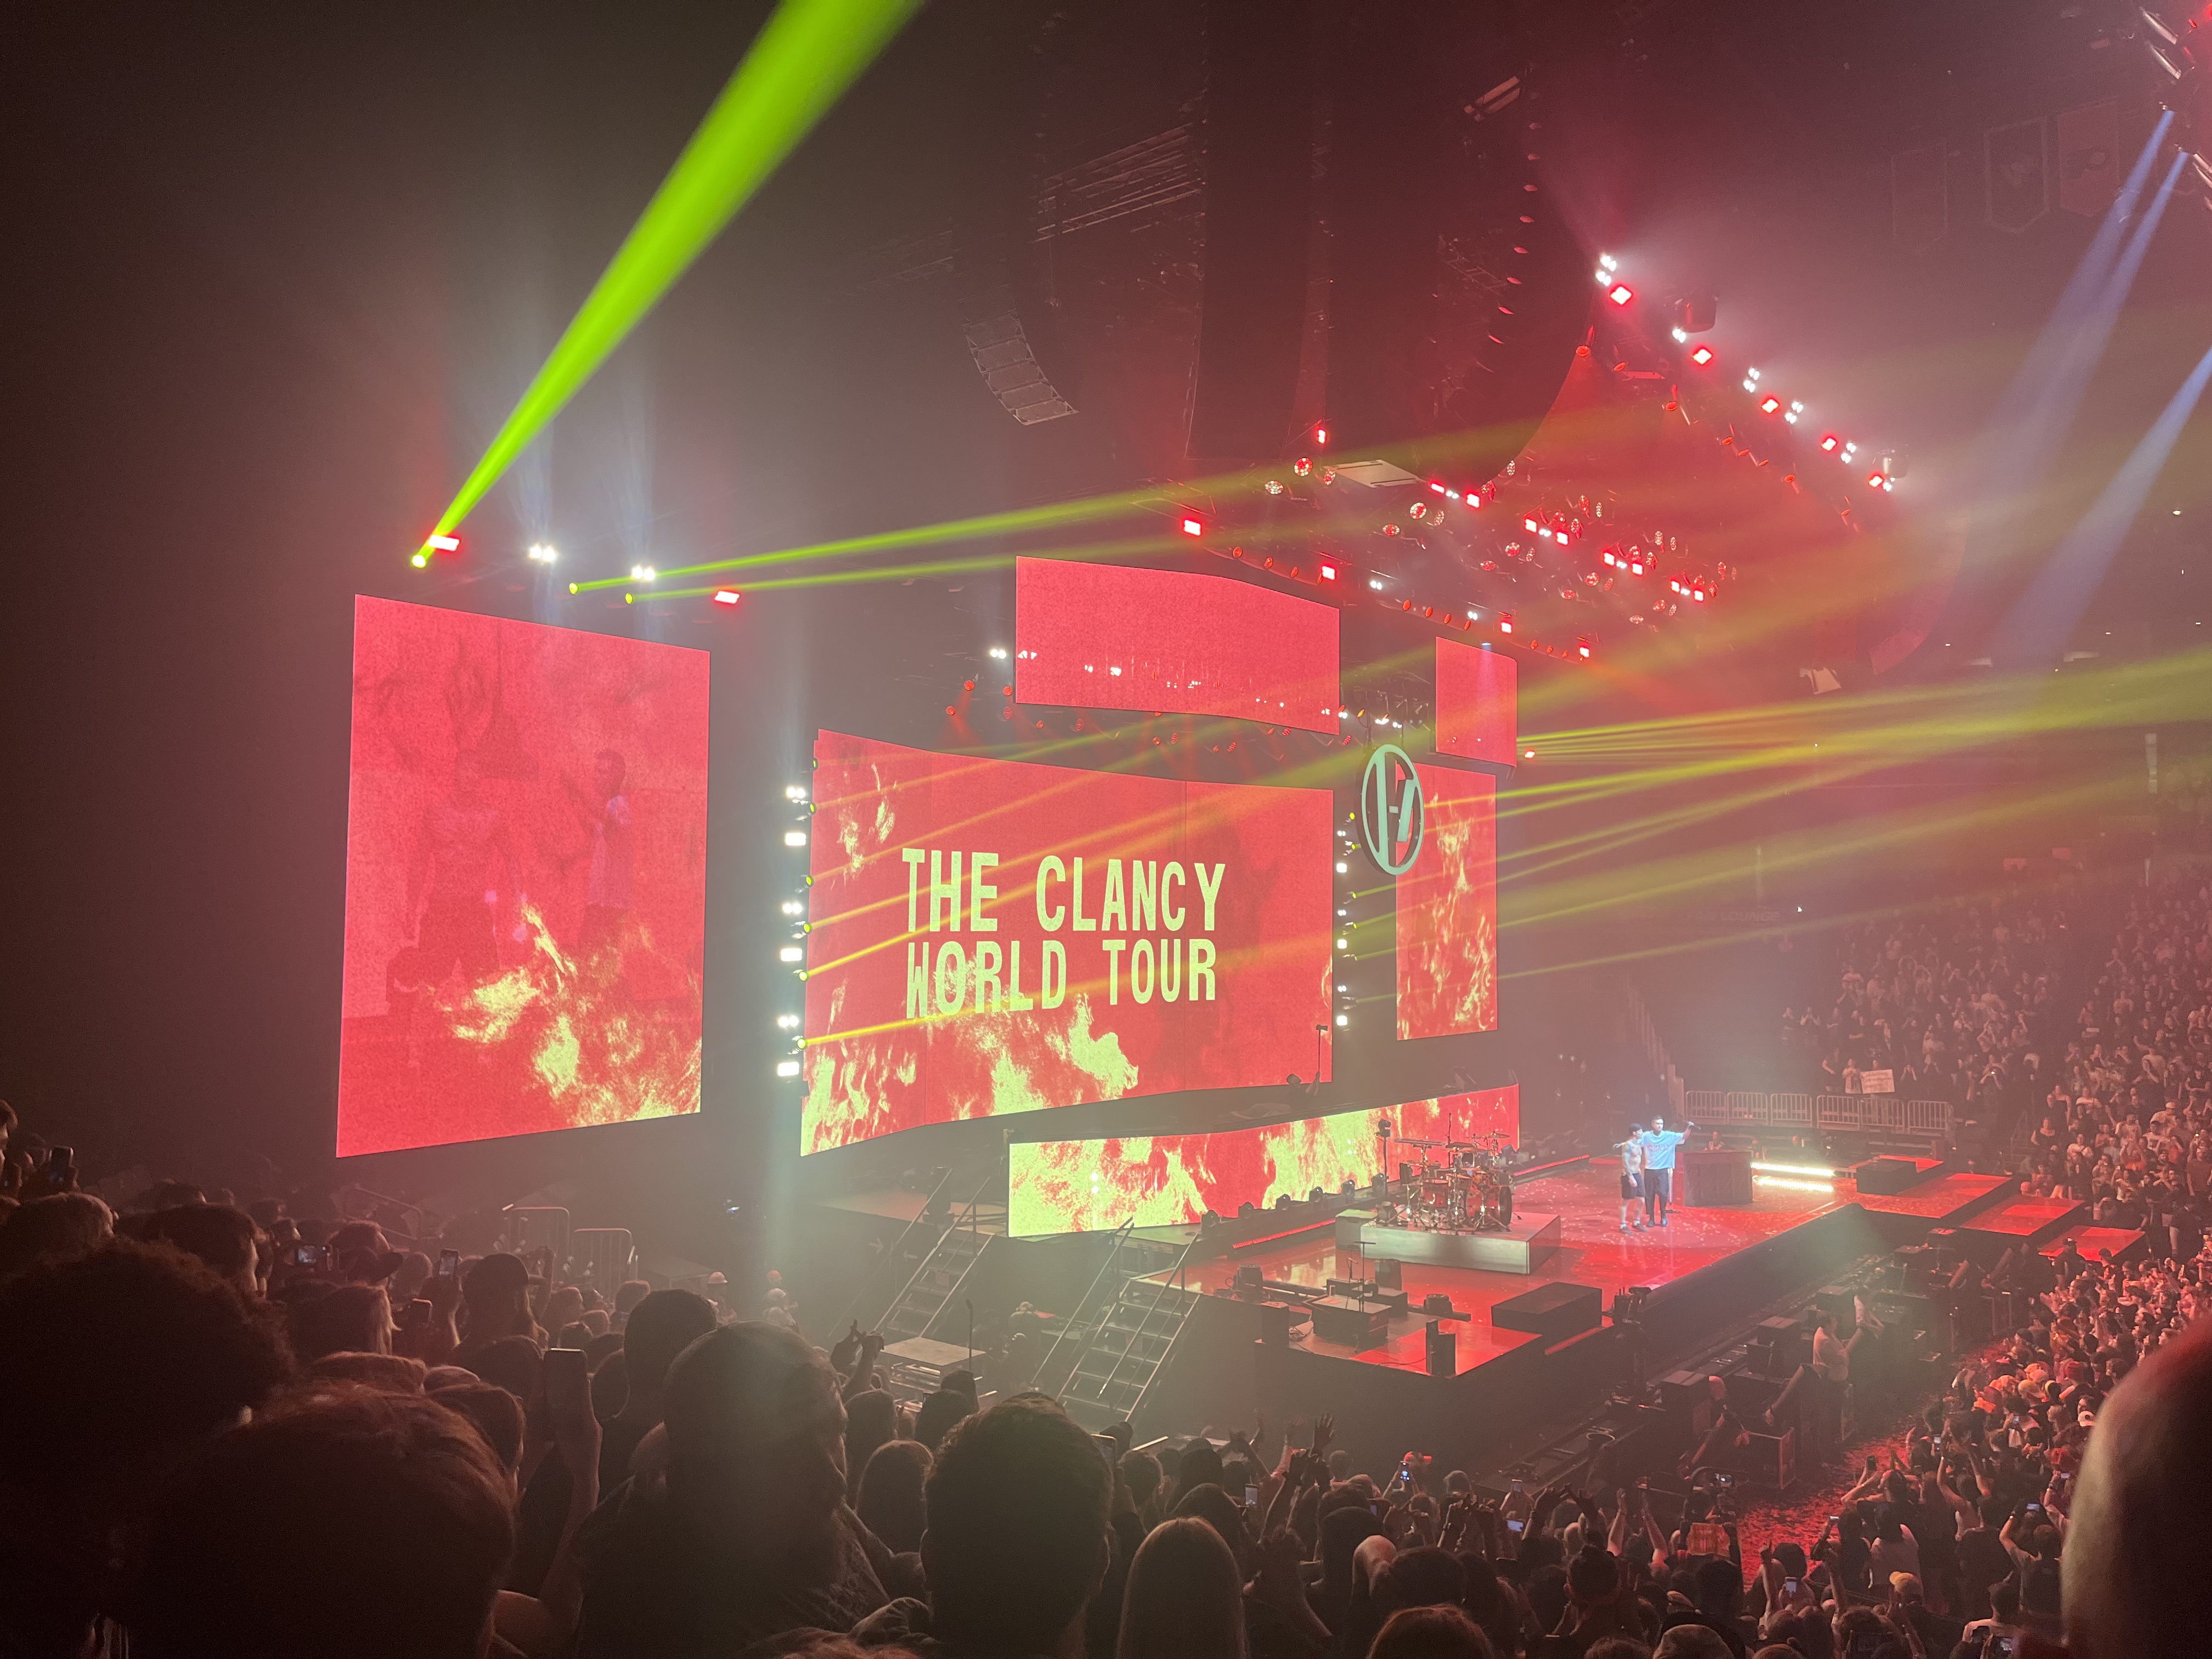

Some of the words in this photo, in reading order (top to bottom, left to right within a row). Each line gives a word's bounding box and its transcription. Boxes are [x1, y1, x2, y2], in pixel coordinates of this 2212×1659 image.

[902, 848, 998, 932] THE
[1036, 855, 1226, 932] CLANCY
[906, 940, 1066, 1019] WORLD
[1102, 939, 1216, 1005] TOUR
